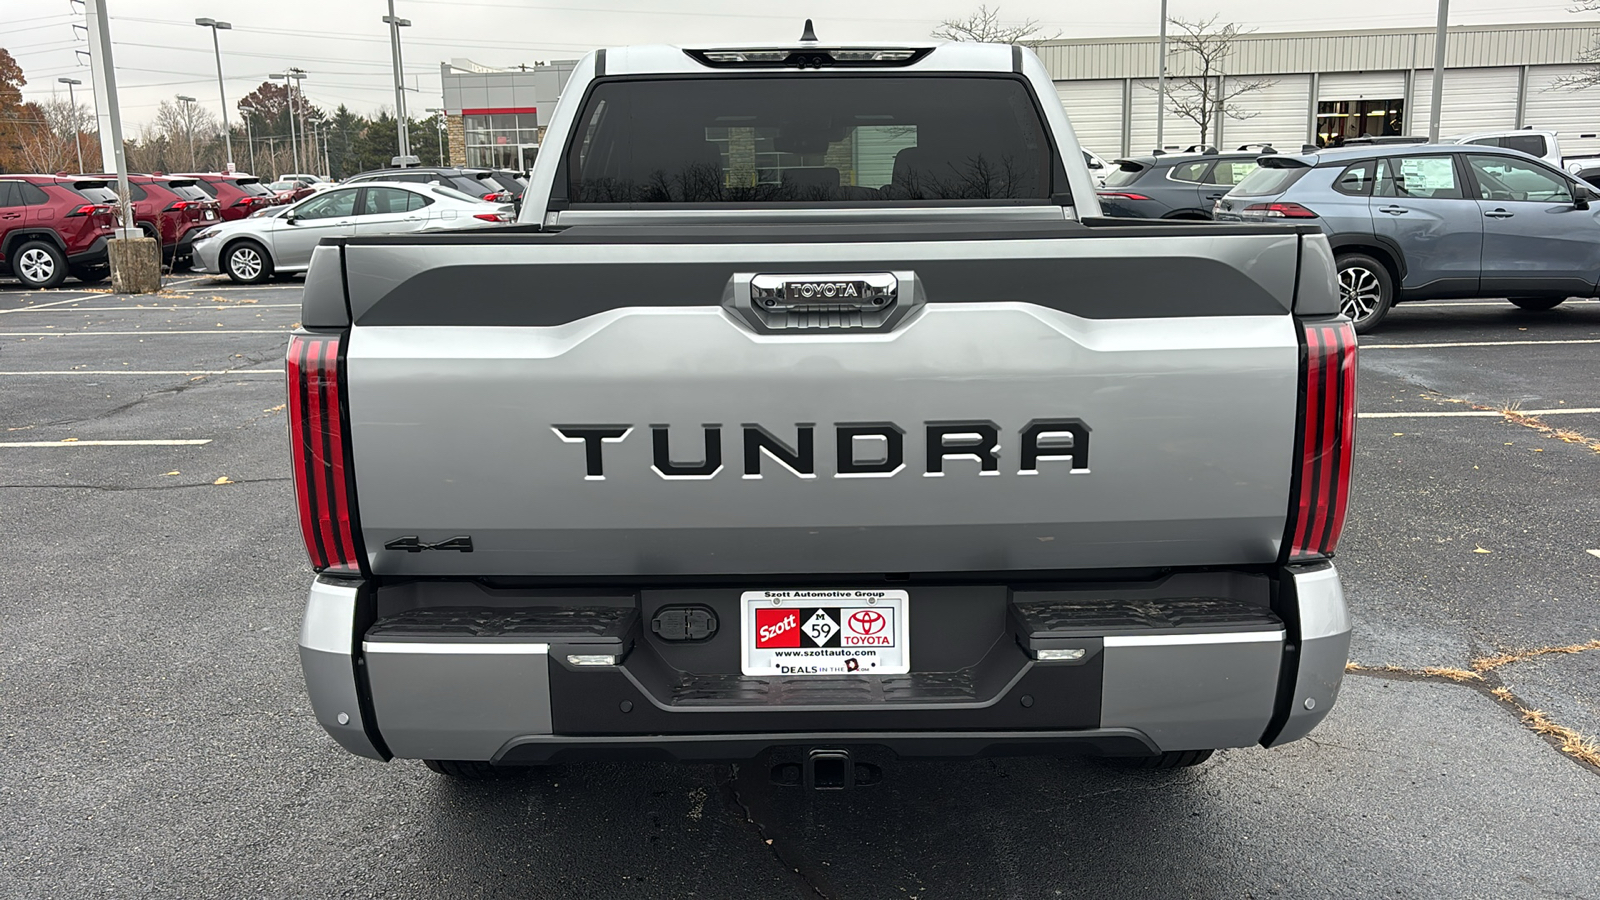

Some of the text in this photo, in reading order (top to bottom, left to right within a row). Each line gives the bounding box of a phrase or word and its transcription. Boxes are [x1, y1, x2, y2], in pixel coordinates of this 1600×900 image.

[791, 283, 857, 297] TOYOTA
[550, 417, 1093, 480] TUNDRA
[854, 590, 885, 598] Group
[759, 613, 797, 642] Szott
[811, 623, 831, 639] 59
[844, 636, 890, 645] TOYOTA
[775, 649, 876, 657] www.szottauto.com
[781, 665, 818, 674] DEALS
